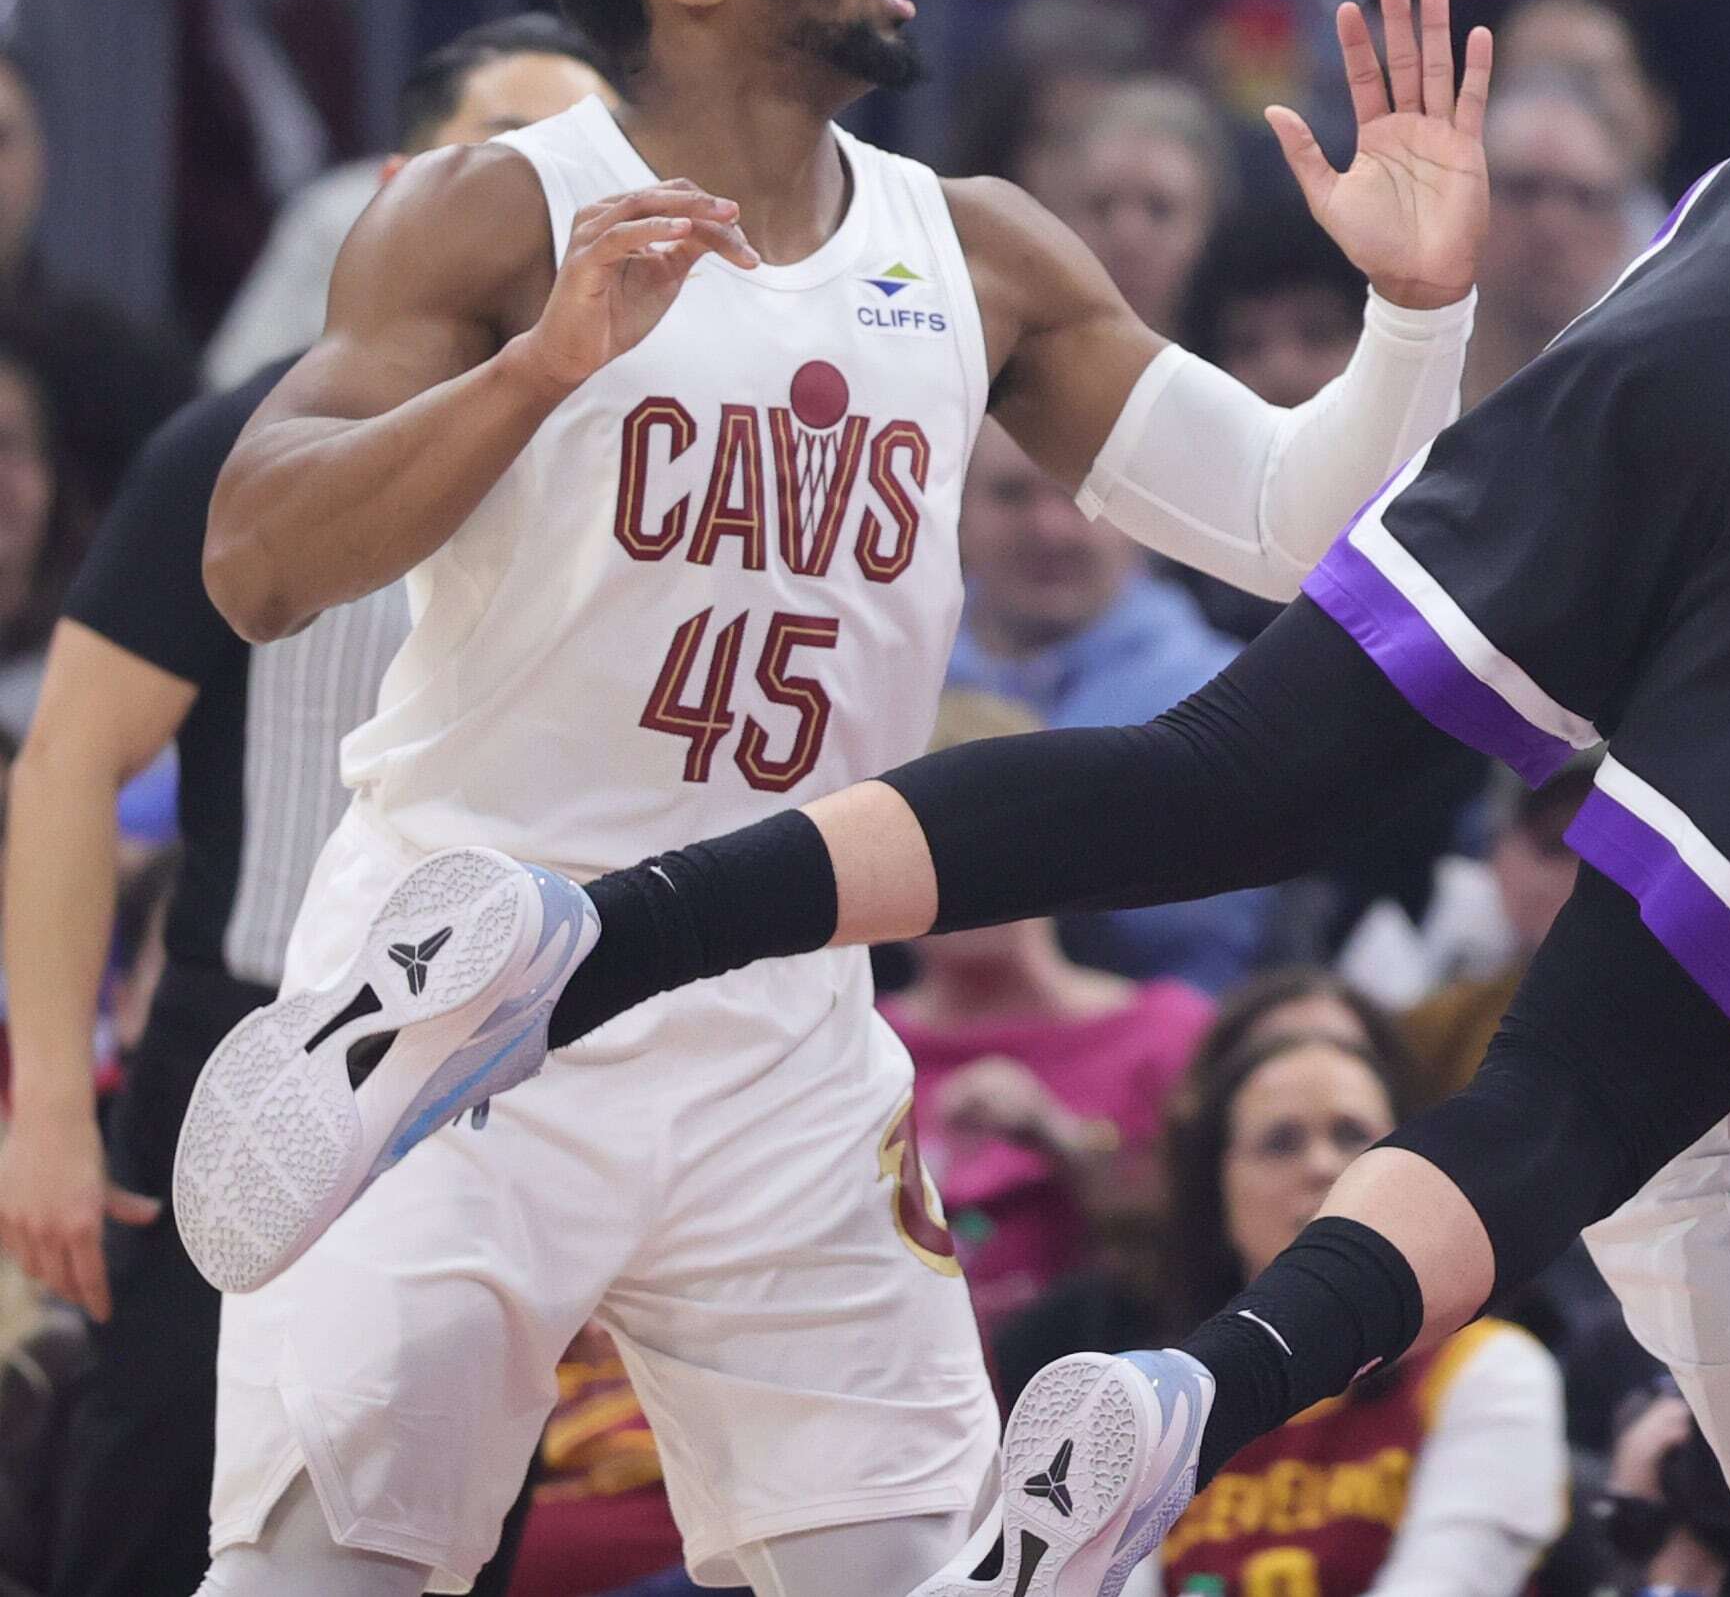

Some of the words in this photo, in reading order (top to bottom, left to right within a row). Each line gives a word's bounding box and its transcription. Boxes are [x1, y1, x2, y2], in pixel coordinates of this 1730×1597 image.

[856, 306, 946, 333] CLIFFS
[614, 395, 931, 584] CAVS
[638, 605, 840, 793] 45
